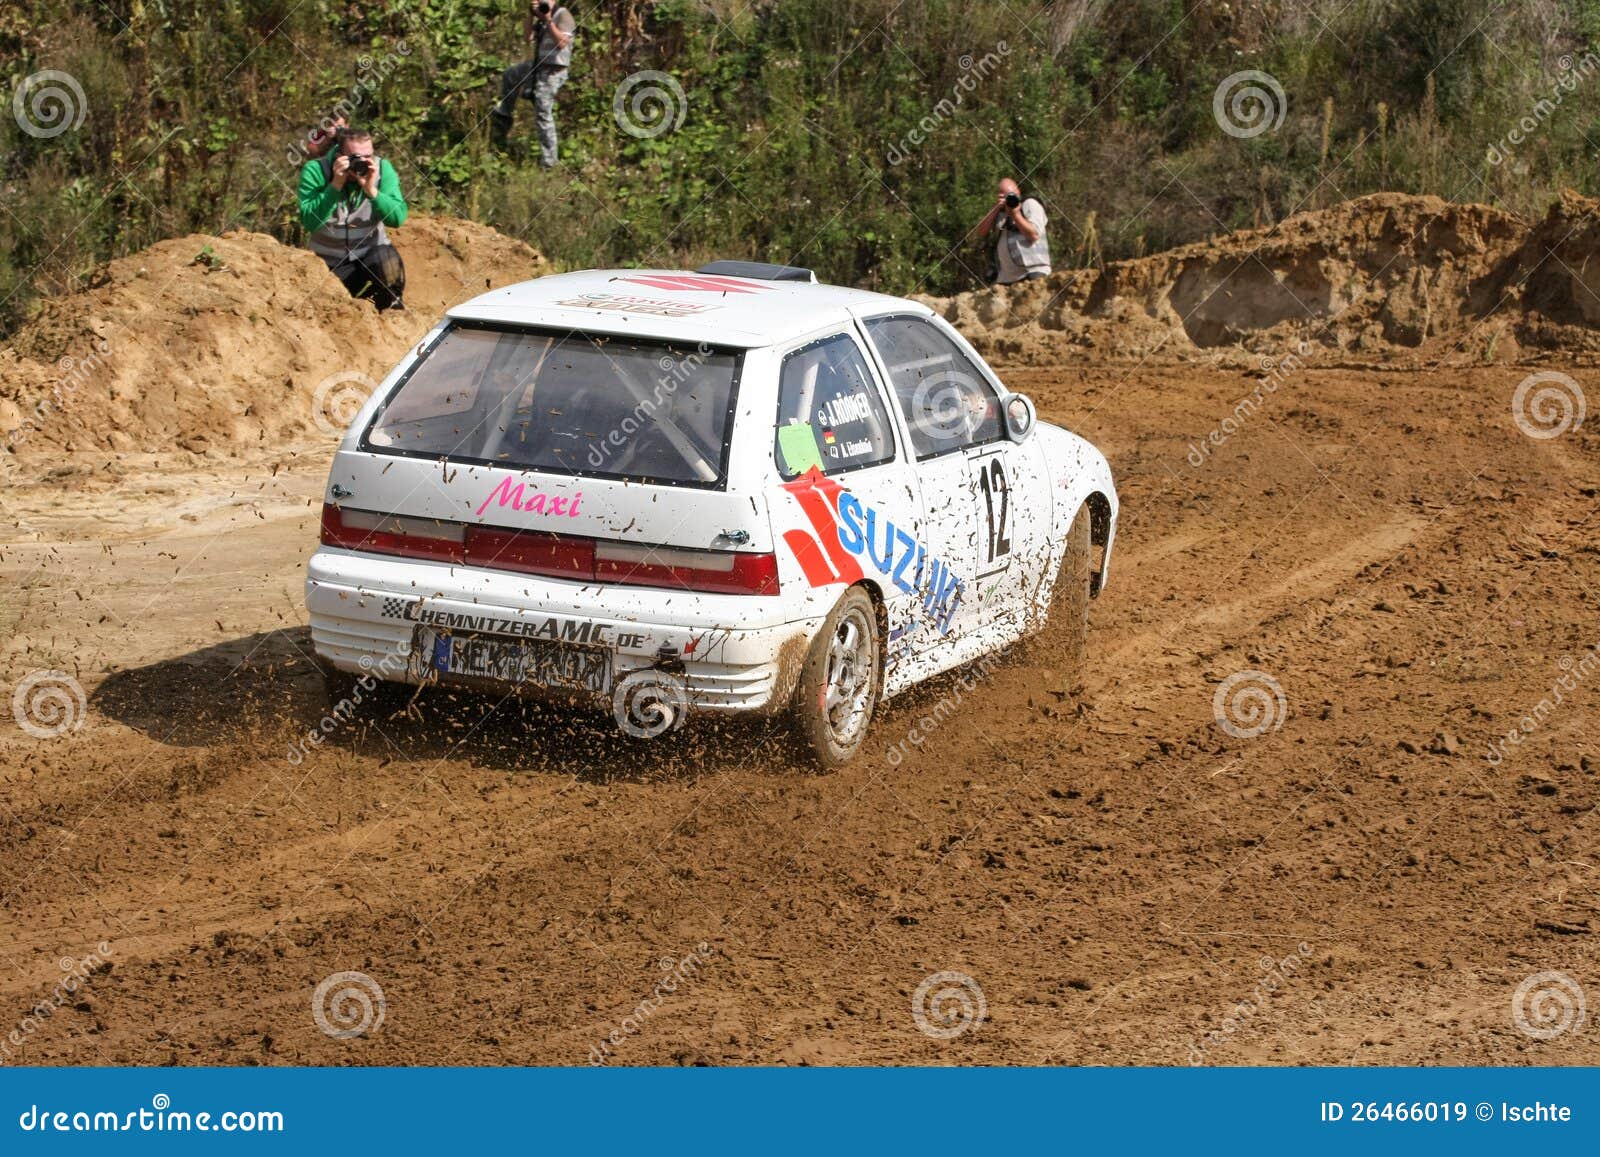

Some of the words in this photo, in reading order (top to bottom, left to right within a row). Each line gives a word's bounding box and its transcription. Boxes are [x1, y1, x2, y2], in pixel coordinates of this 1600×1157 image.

[476, 475, 583, 518] Maxi
[979, 458, 1011, 563] 12
[838, 492, 966, 637] SUZUKI
